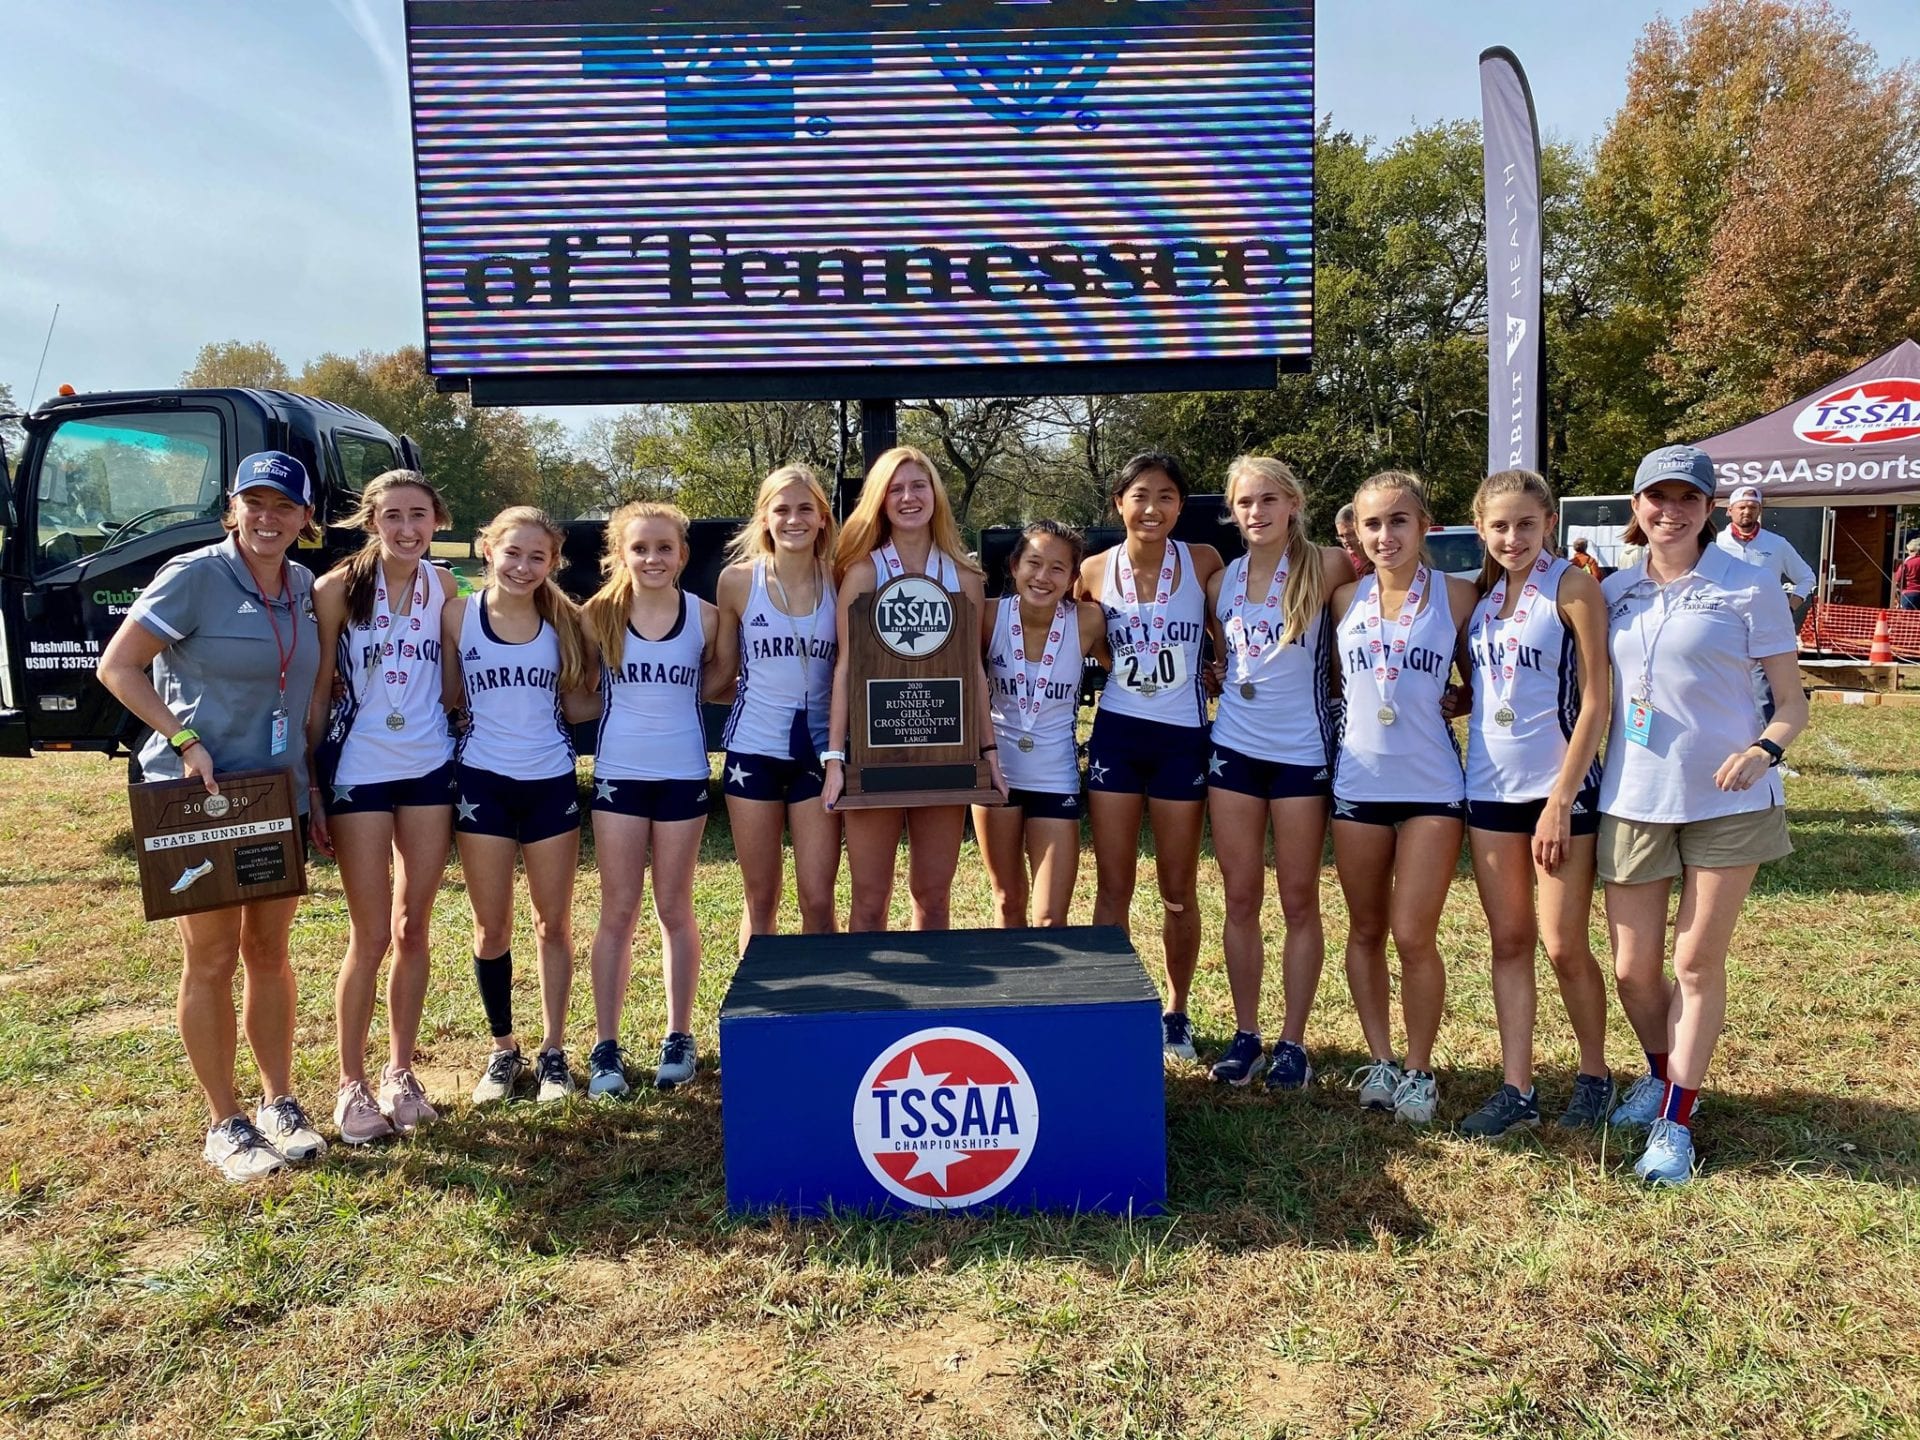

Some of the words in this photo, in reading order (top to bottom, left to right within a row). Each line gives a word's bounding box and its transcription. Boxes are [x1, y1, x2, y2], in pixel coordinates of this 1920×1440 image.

[1503, 163, 1522, 299] HEALTH
[464, 231, 597, 309] of
[631, 228, 1293, 304] Tennessee
[1509, 371, 1524, 468] RBILT
[1815, 402, 1920, 427] TSSA
[253, 466, 288, 478] FARRAGUT
[881, 602, 947, 627] TSSAA
[30, 640, 84, 653] Nashville,
[84, 640, 99, 653] TN
[25, 657, 60, 669] USDOT
[61, 656, 101, 669] 337521
[1124, 649, 1176, 687] 20
[469, 666, 557, 694] FARRAGUT
[907, 682, 923, 690] 2020
[899, 690, 931, 699] STATE
[886, 699, 945, 709] RUNNER-UP
[900, 709, 931, 718] GIRLS
[874, 718, 906, 728] CROSS
[907, 717, 956, 726] COUNTRY
[894, 727, 932, 736] DIVISION
[184, 803, 201, 815] 20
[232, 796, 249, 808] 20
[153, 834, 196, 848] STATE
[872, 1086, 1020, 1139] TSSAA
[895, 1138, 999, 1151] CHAMPIONSHIPS
